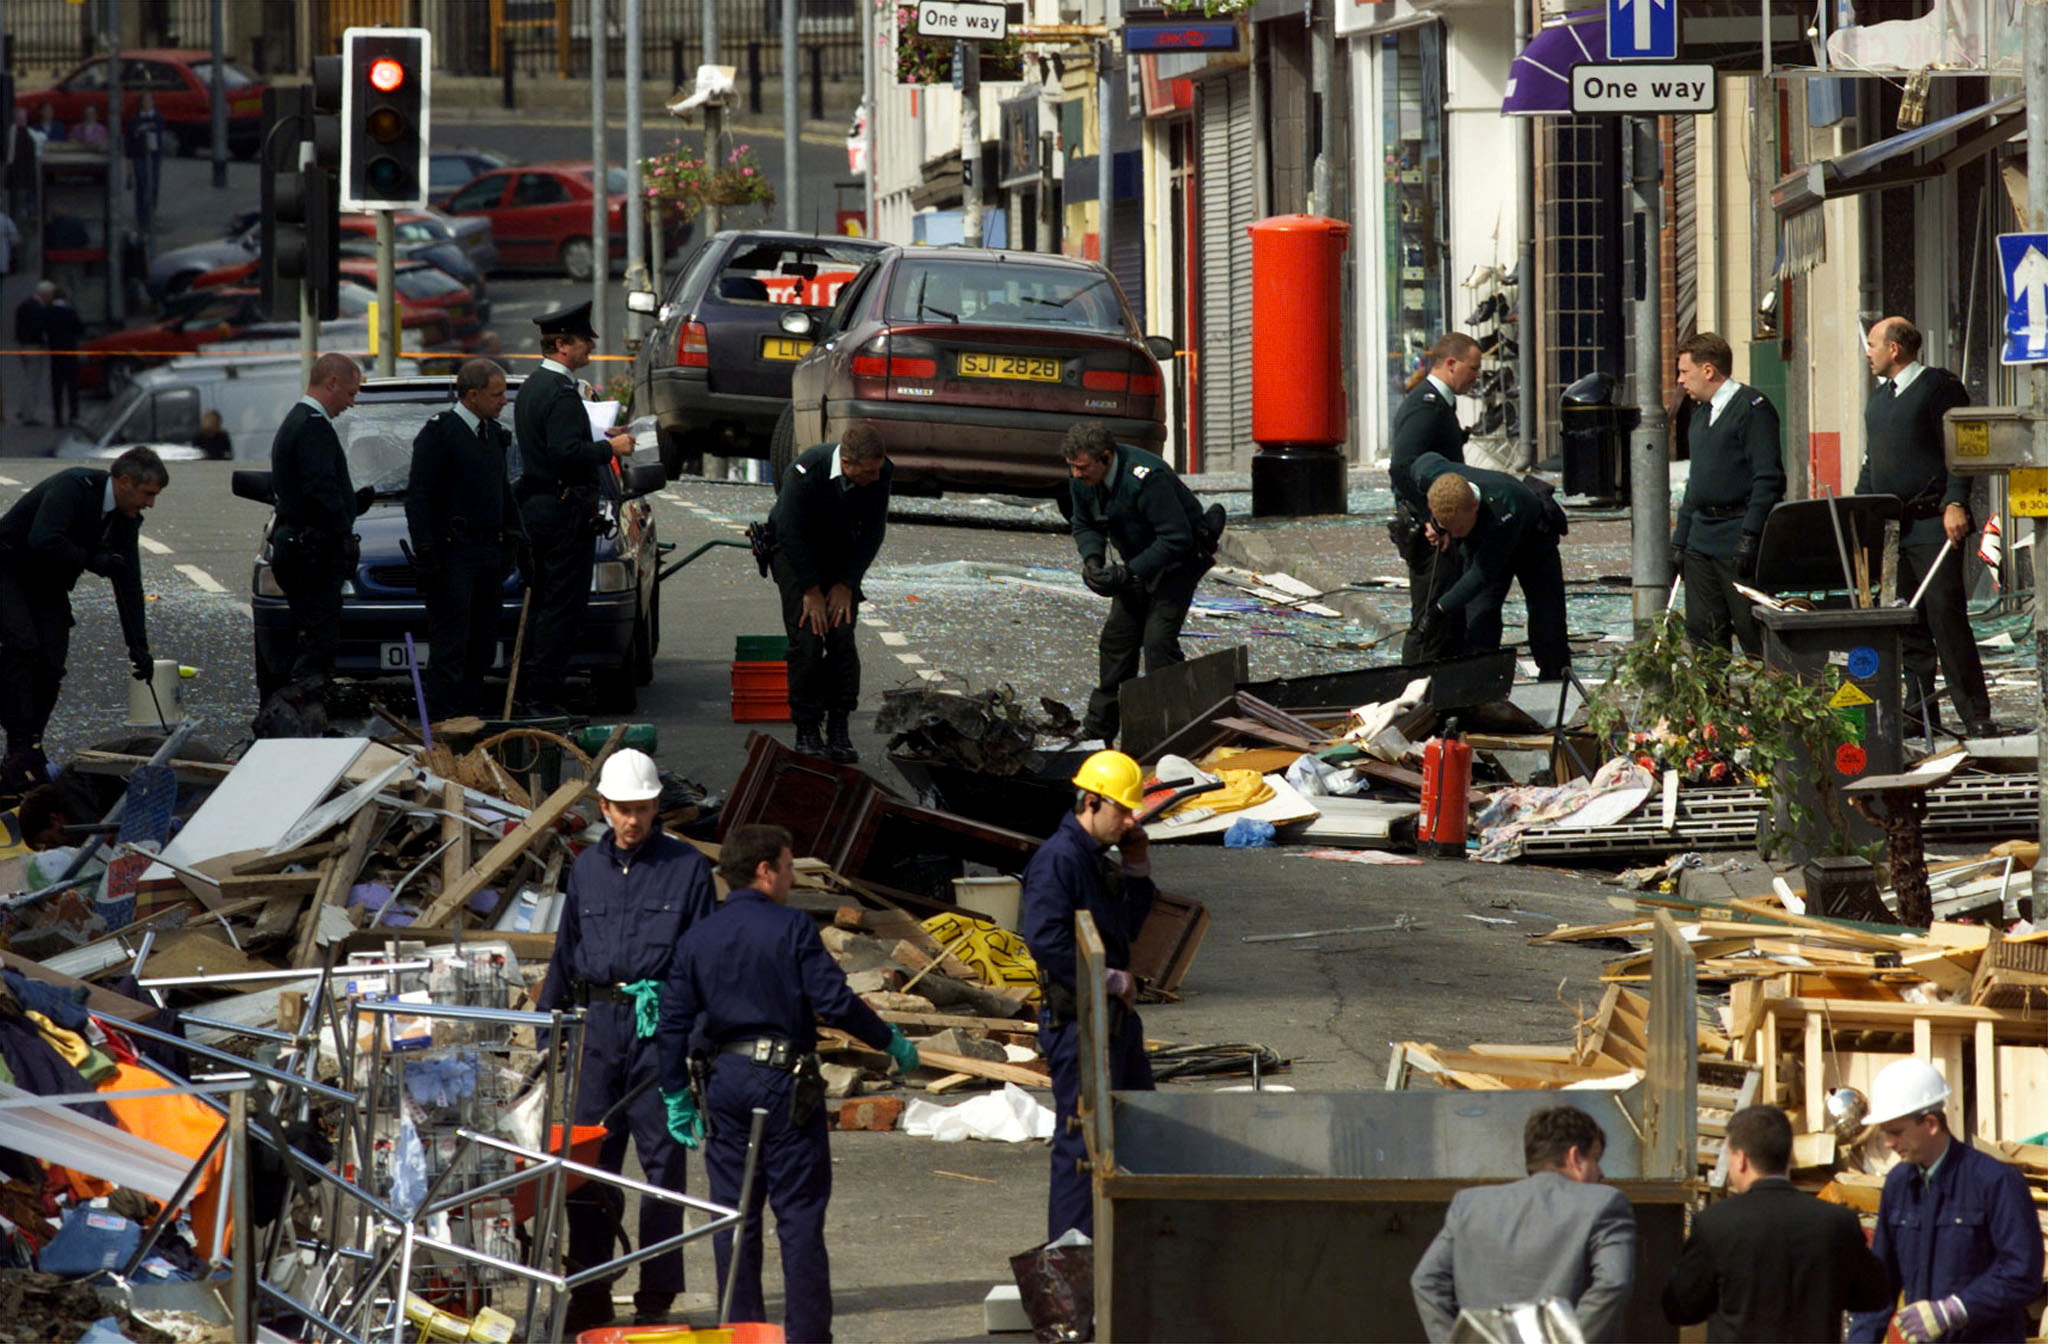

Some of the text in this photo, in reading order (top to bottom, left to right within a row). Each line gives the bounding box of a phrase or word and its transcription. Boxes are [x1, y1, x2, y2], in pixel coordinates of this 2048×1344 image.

[925, 9, 1000, 33] One way
[1583, 76, 1706, 102] One way
[964, 355, 1056, 377] SJI 2828
